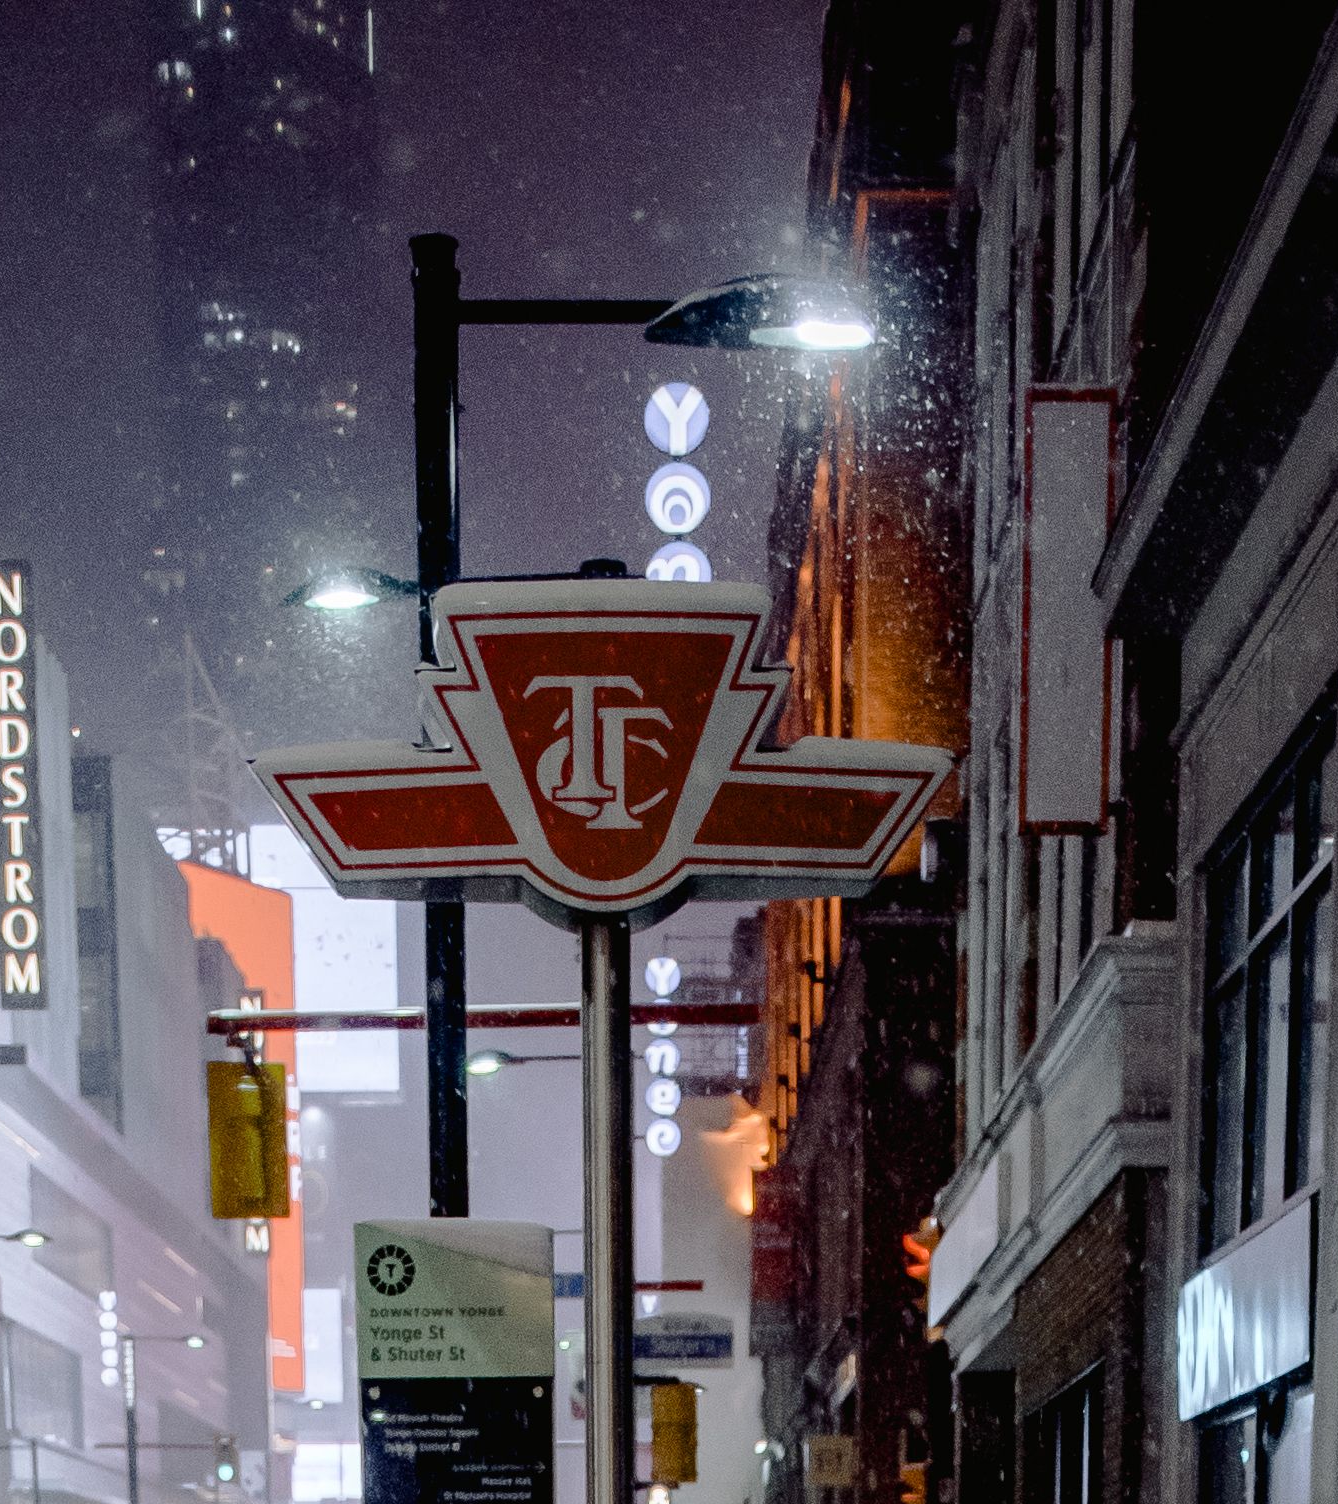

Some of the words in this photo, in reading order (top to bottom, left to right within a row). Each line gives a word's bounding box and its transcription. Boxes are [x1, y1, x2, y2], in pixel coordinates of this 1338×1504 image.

[522, 675, 675, 831] TTC
[369, 1306, 454, 1318] DOWNTOWN
[370, 1325, 422, 1342] Yonge
[428, 1325, 445, 1340] St
[370, 1347, 381, 1361] &
[388, 1347, 442, 1361] Shuter
[449, 1346, 465, 1361] St
